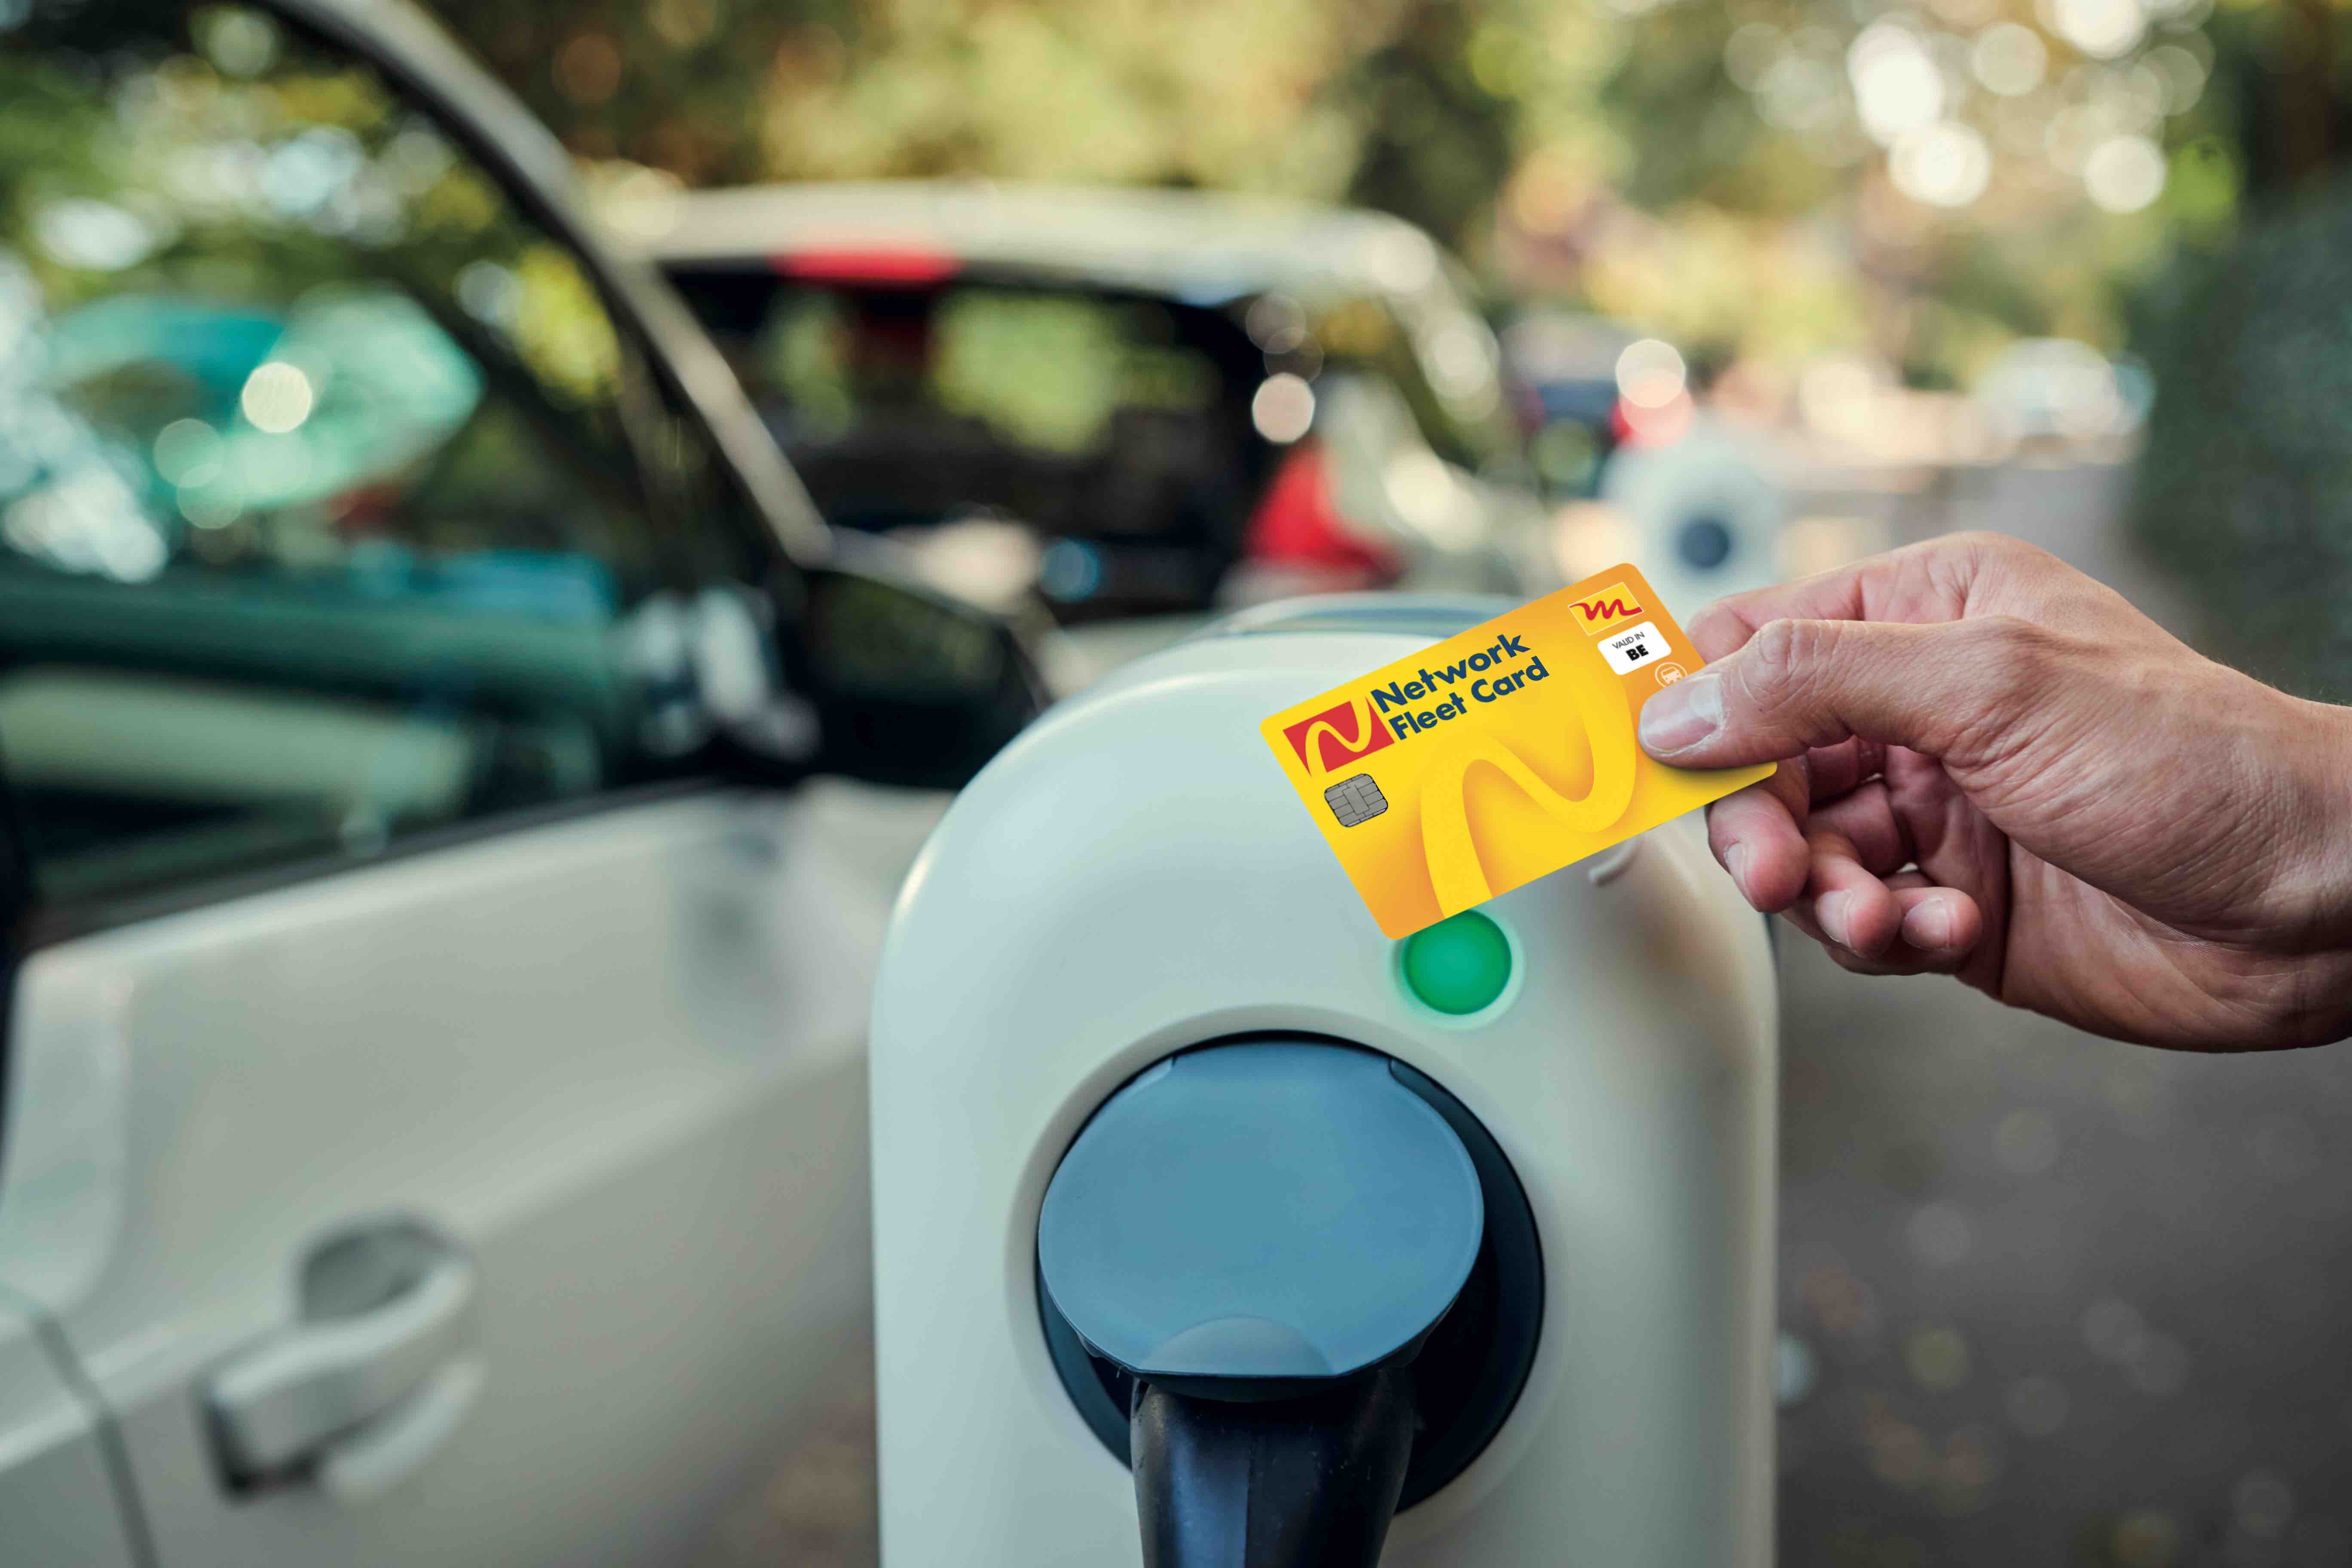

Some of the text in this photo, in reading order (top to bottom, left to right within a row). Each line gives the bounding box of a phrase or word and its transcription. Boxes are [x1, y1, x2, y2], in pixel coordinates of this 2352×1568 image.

[1611, 631, 1645, 649] VALID IN
[1625, 644, 1649, 661] BE
[1371, 634, 1531, 713] Network
[1389, 656, 1549, 740] Fleet Card
